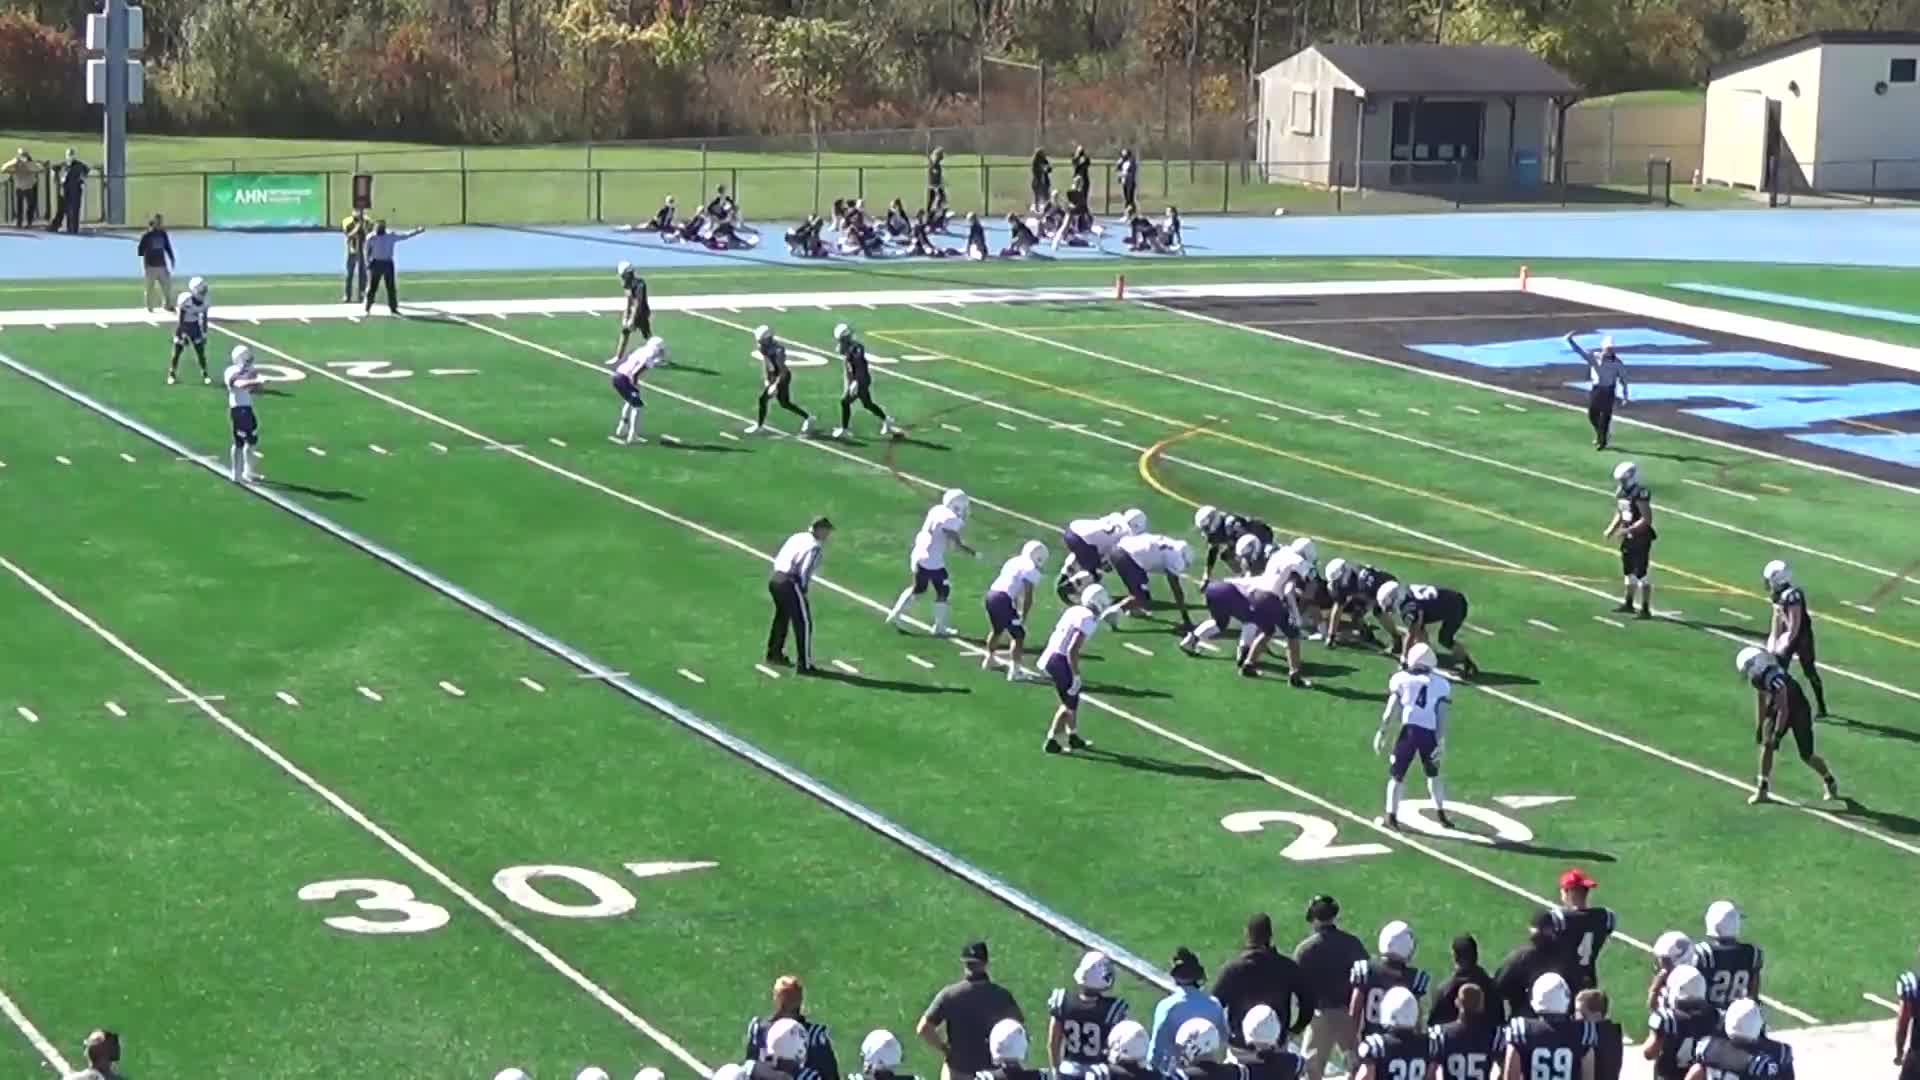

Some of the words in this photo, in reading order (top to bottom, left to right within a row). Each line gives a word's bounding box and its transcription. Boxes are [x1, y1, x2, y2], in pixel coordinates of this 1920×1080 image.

[234, 189, 268, 203] AHN
[1415, 684, 1428, 710] 4
[1220, 799, 1534, 862] 20
[298, 864, 638, 934] 30
[1577, 931, 1594, 966] 4
[1063, 1020, 1101, 1057] 33
[1447, 1053, 1488, 1080] 95
[1531, 1047, 1573, 1080] 69
